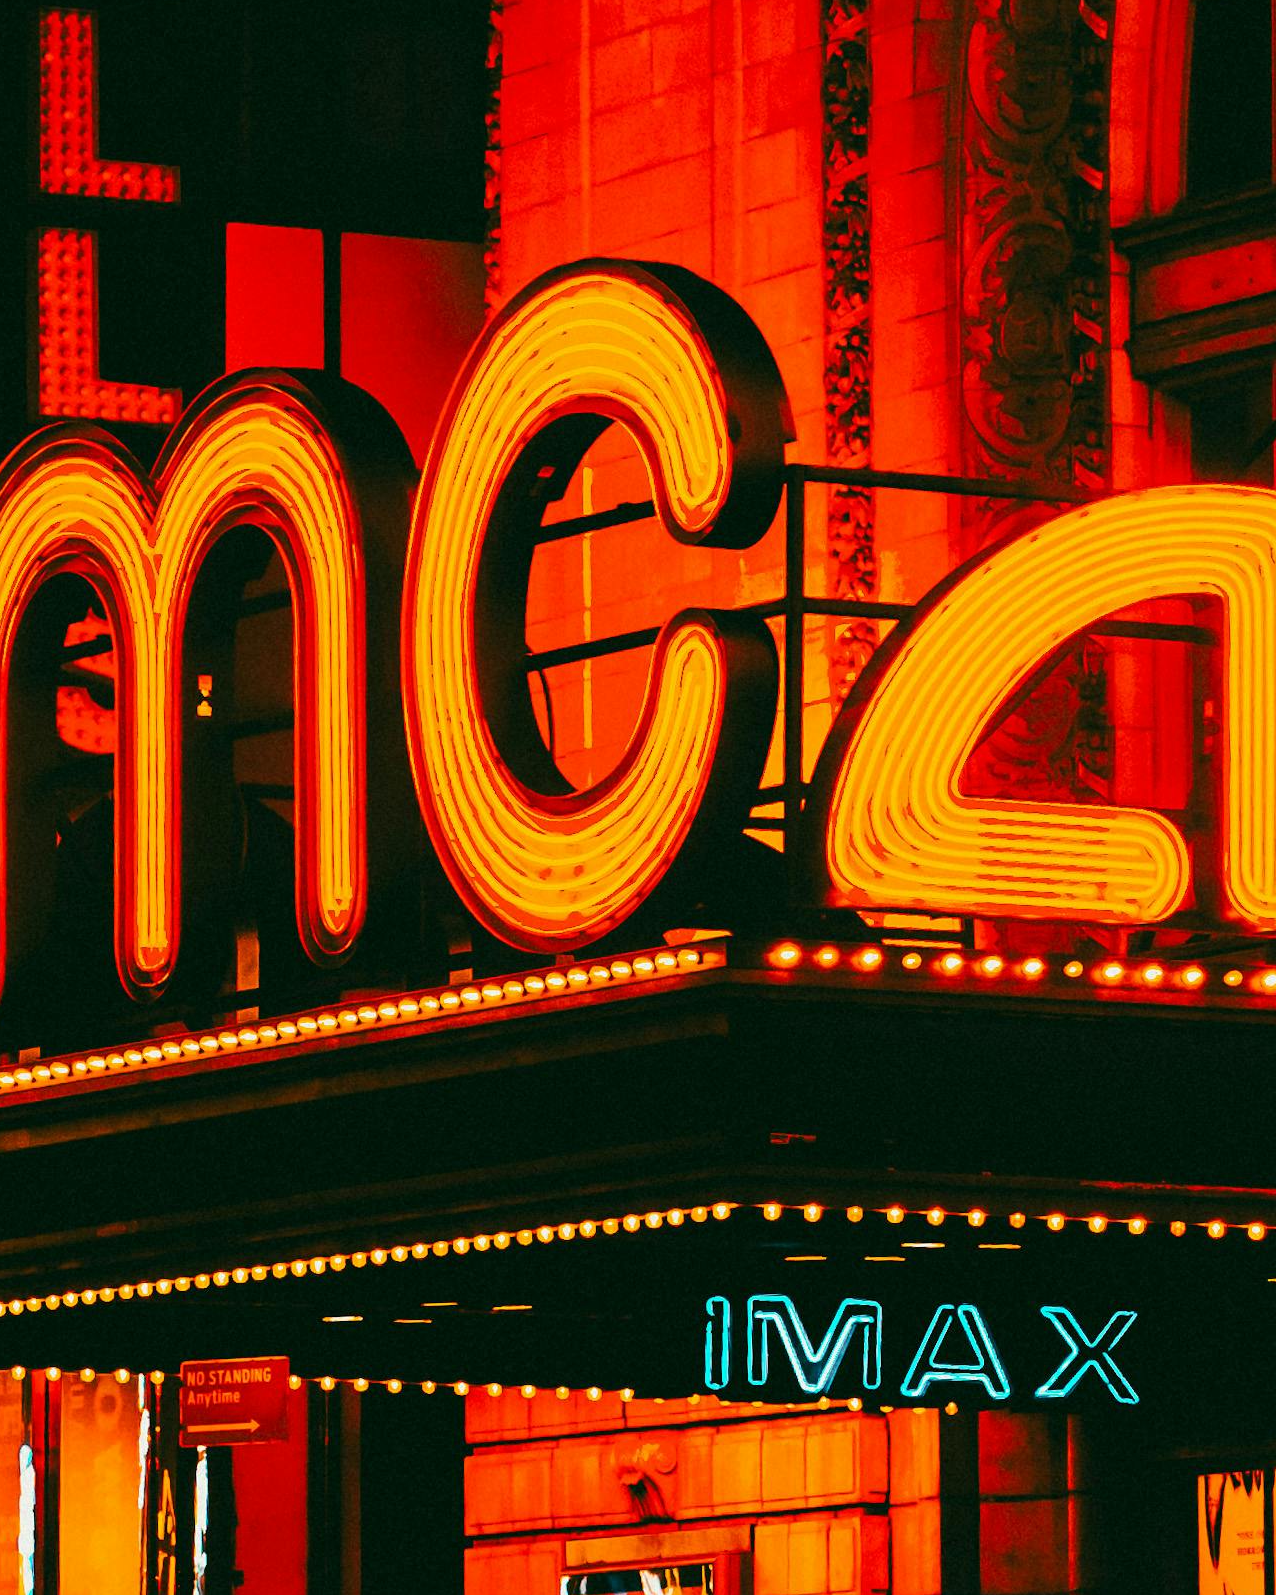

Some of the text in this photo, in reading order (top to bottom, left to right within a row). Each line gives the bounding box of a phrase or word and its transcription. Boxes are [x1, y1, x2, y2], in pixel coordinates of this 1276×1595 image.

[704, 1294, 1141, 1405] IMAX
[187, 1366, 272, 1387] NO STANDING
[187, 1389, 241, 1408] Anytime
